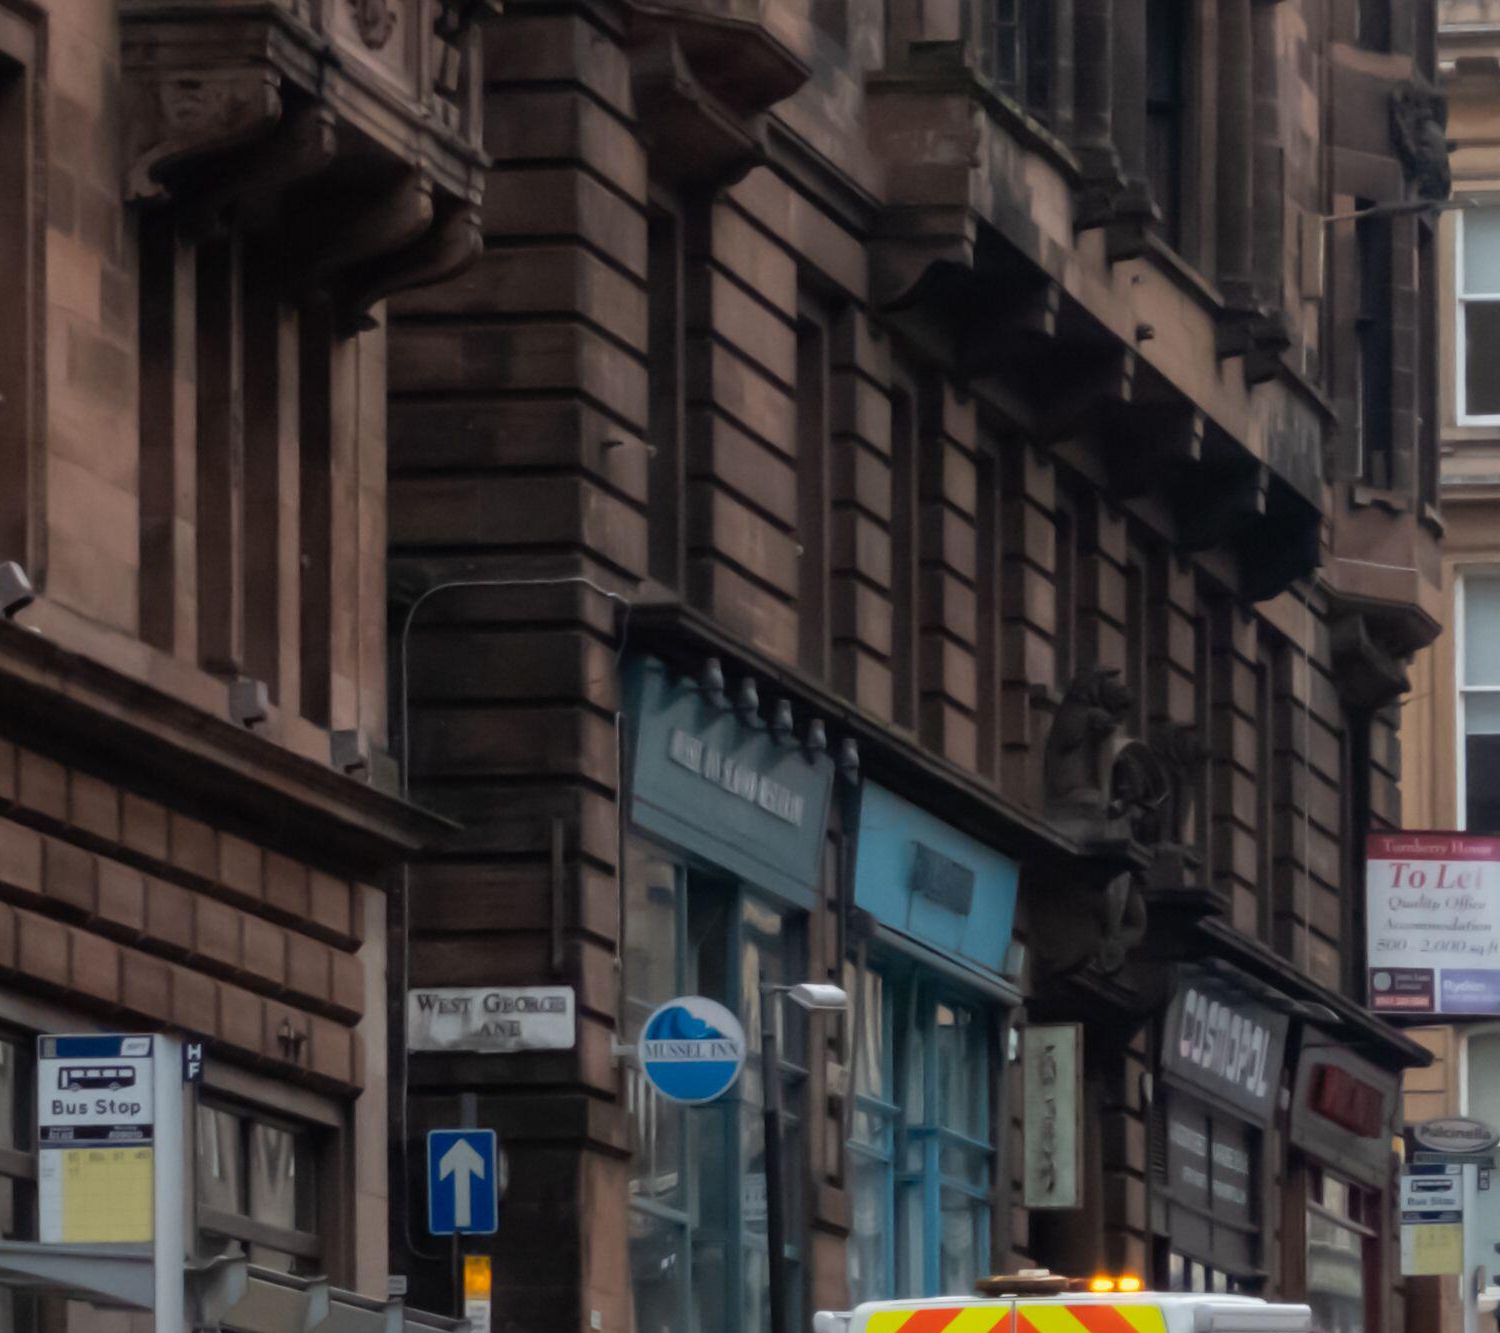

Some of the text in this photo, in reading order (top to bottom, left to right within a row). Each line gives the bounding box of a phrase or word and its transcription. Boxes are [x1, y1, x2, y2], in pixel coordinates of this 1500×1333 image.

[1389, 862, 1426, 889] To
[1389, 895, 1487, 912] Quality Office
[1383, 917, 1493, 931] Accommodation
[416, 993, 473, 1015] WEST
[473, 1019, 522, 1037] ANE
[709, 1042, 739, 1058] INN
[52, 1099, 142, 1117] Bus Stop
[1419, 1125, 1492, 1141] Pulcinella
